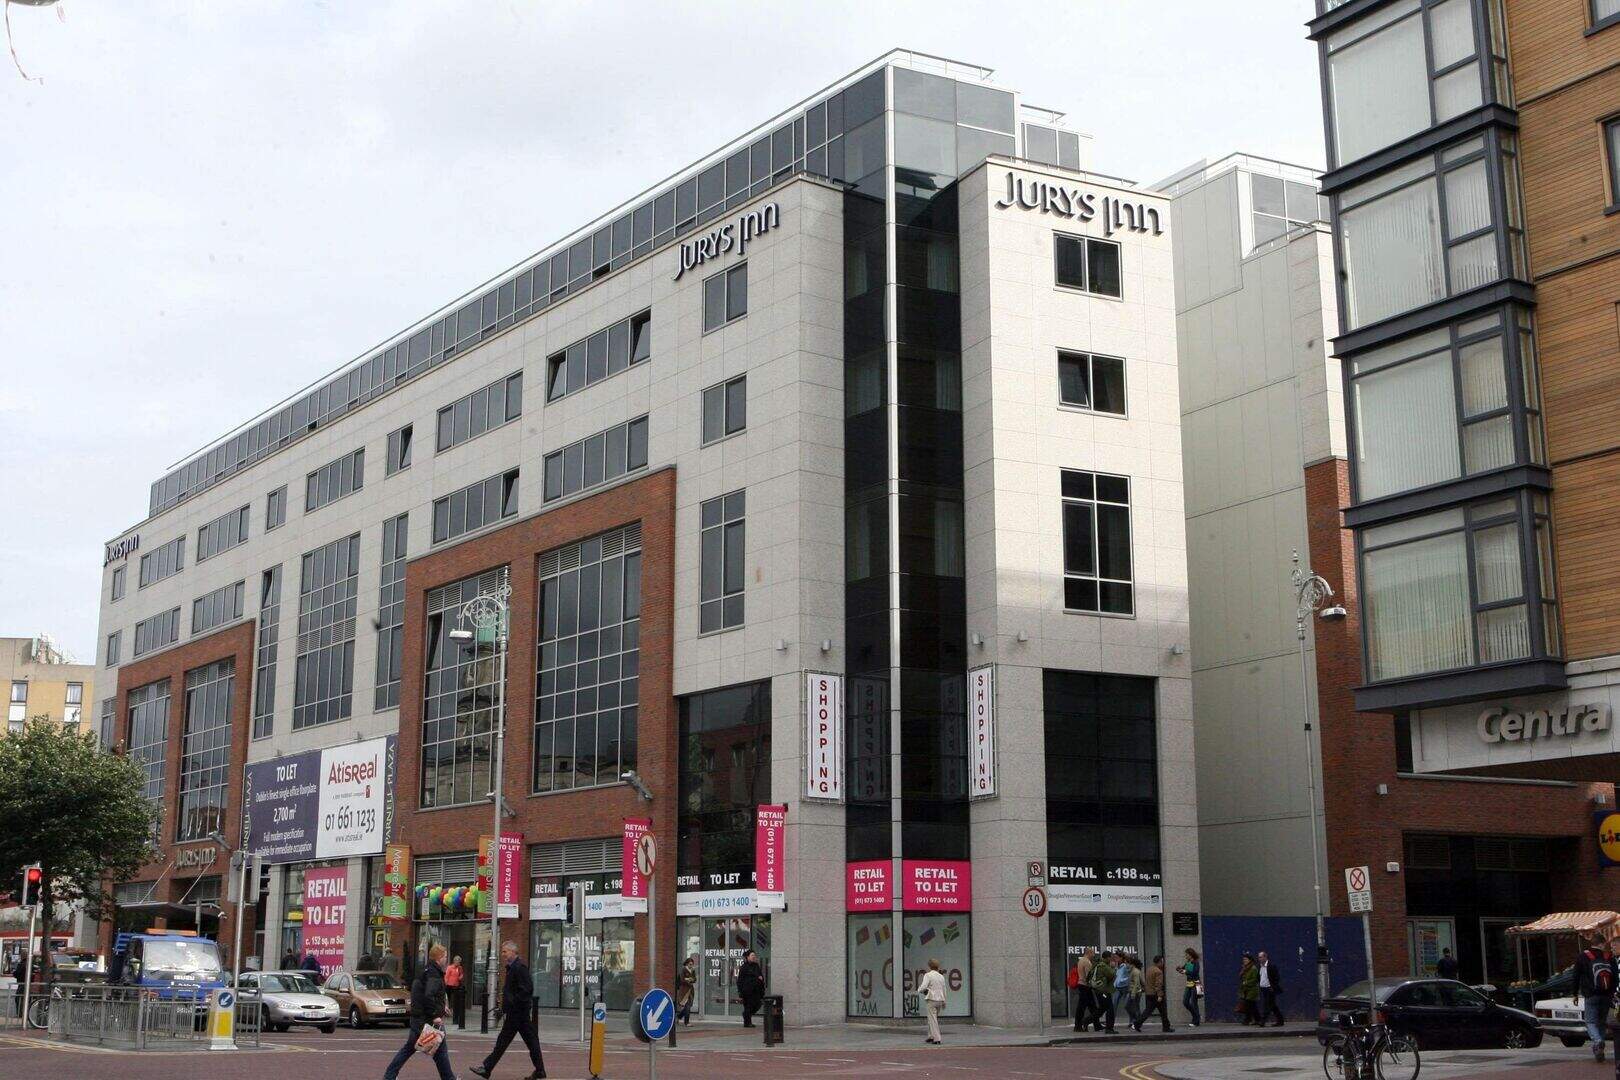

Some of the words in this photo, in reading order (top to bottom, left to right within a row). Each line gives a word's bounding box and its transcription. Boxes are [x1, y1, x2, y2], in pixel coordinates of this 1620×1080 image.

[994, 172, 1097, 222] JURYS
[1102, 196, 1164, 237] Inn
[672, 224, 735, 281] JURYS
[737, 202, 780, 255] Inn
[1477, 703, 1613, 744] Centra
[819, 680, 829, 793] SHOPPING
[977, 675, 986, 790] SHOPPING
[277, 766, 285, 782] TO
[286, 763, 297, 780] LET
[326, 814, 334, 831] 01
[338, 805, 353, 829] 661
[357, 808, 375, 833] 1233
[759, 811, 784, 819] RETAIL
[625, 823, 648, 831] RETAIL
[766, 827, 775, 846] (01)
[854, 868, 885, 880] RETAIL
[915, 868, 958, 880] RETAIL
[1050, 866, 1098, 879] RETAIL
[677, 875, 700, 886] RETAIL
[710, 874, 721, 885] TO
[723, 873, 741, 885] LET
[307, 878, 348, 898] RETAIL
[535, 883, 559, 894] RETAIL
[584, 881, 595, 890] ET
[854, 883, 866, 893] TO
[868, 882, 885, 893] LET
[915, 882, 932, 892] TO
[935, 882, 958, 893] LET
[588, 902, 603, 911] 1400
[702, 898, 715, 909] (01)
[717, 897, 730, 907] 673
[732, 896, 750, 907] 1400
[1028, 894, 1040, 907] 30
[307, 906, 322, 925] TO
[325, 905, 347, 925] LET
[705, 948, 726, 957] RETAIL
[1068, 945, 1100, 954] RETIL
[562, 956, 577, 971] TO
[586, 956, 600, 971] ET
[711, 958, 720, 967] TO
[562, 975, 574, 985] (01)
